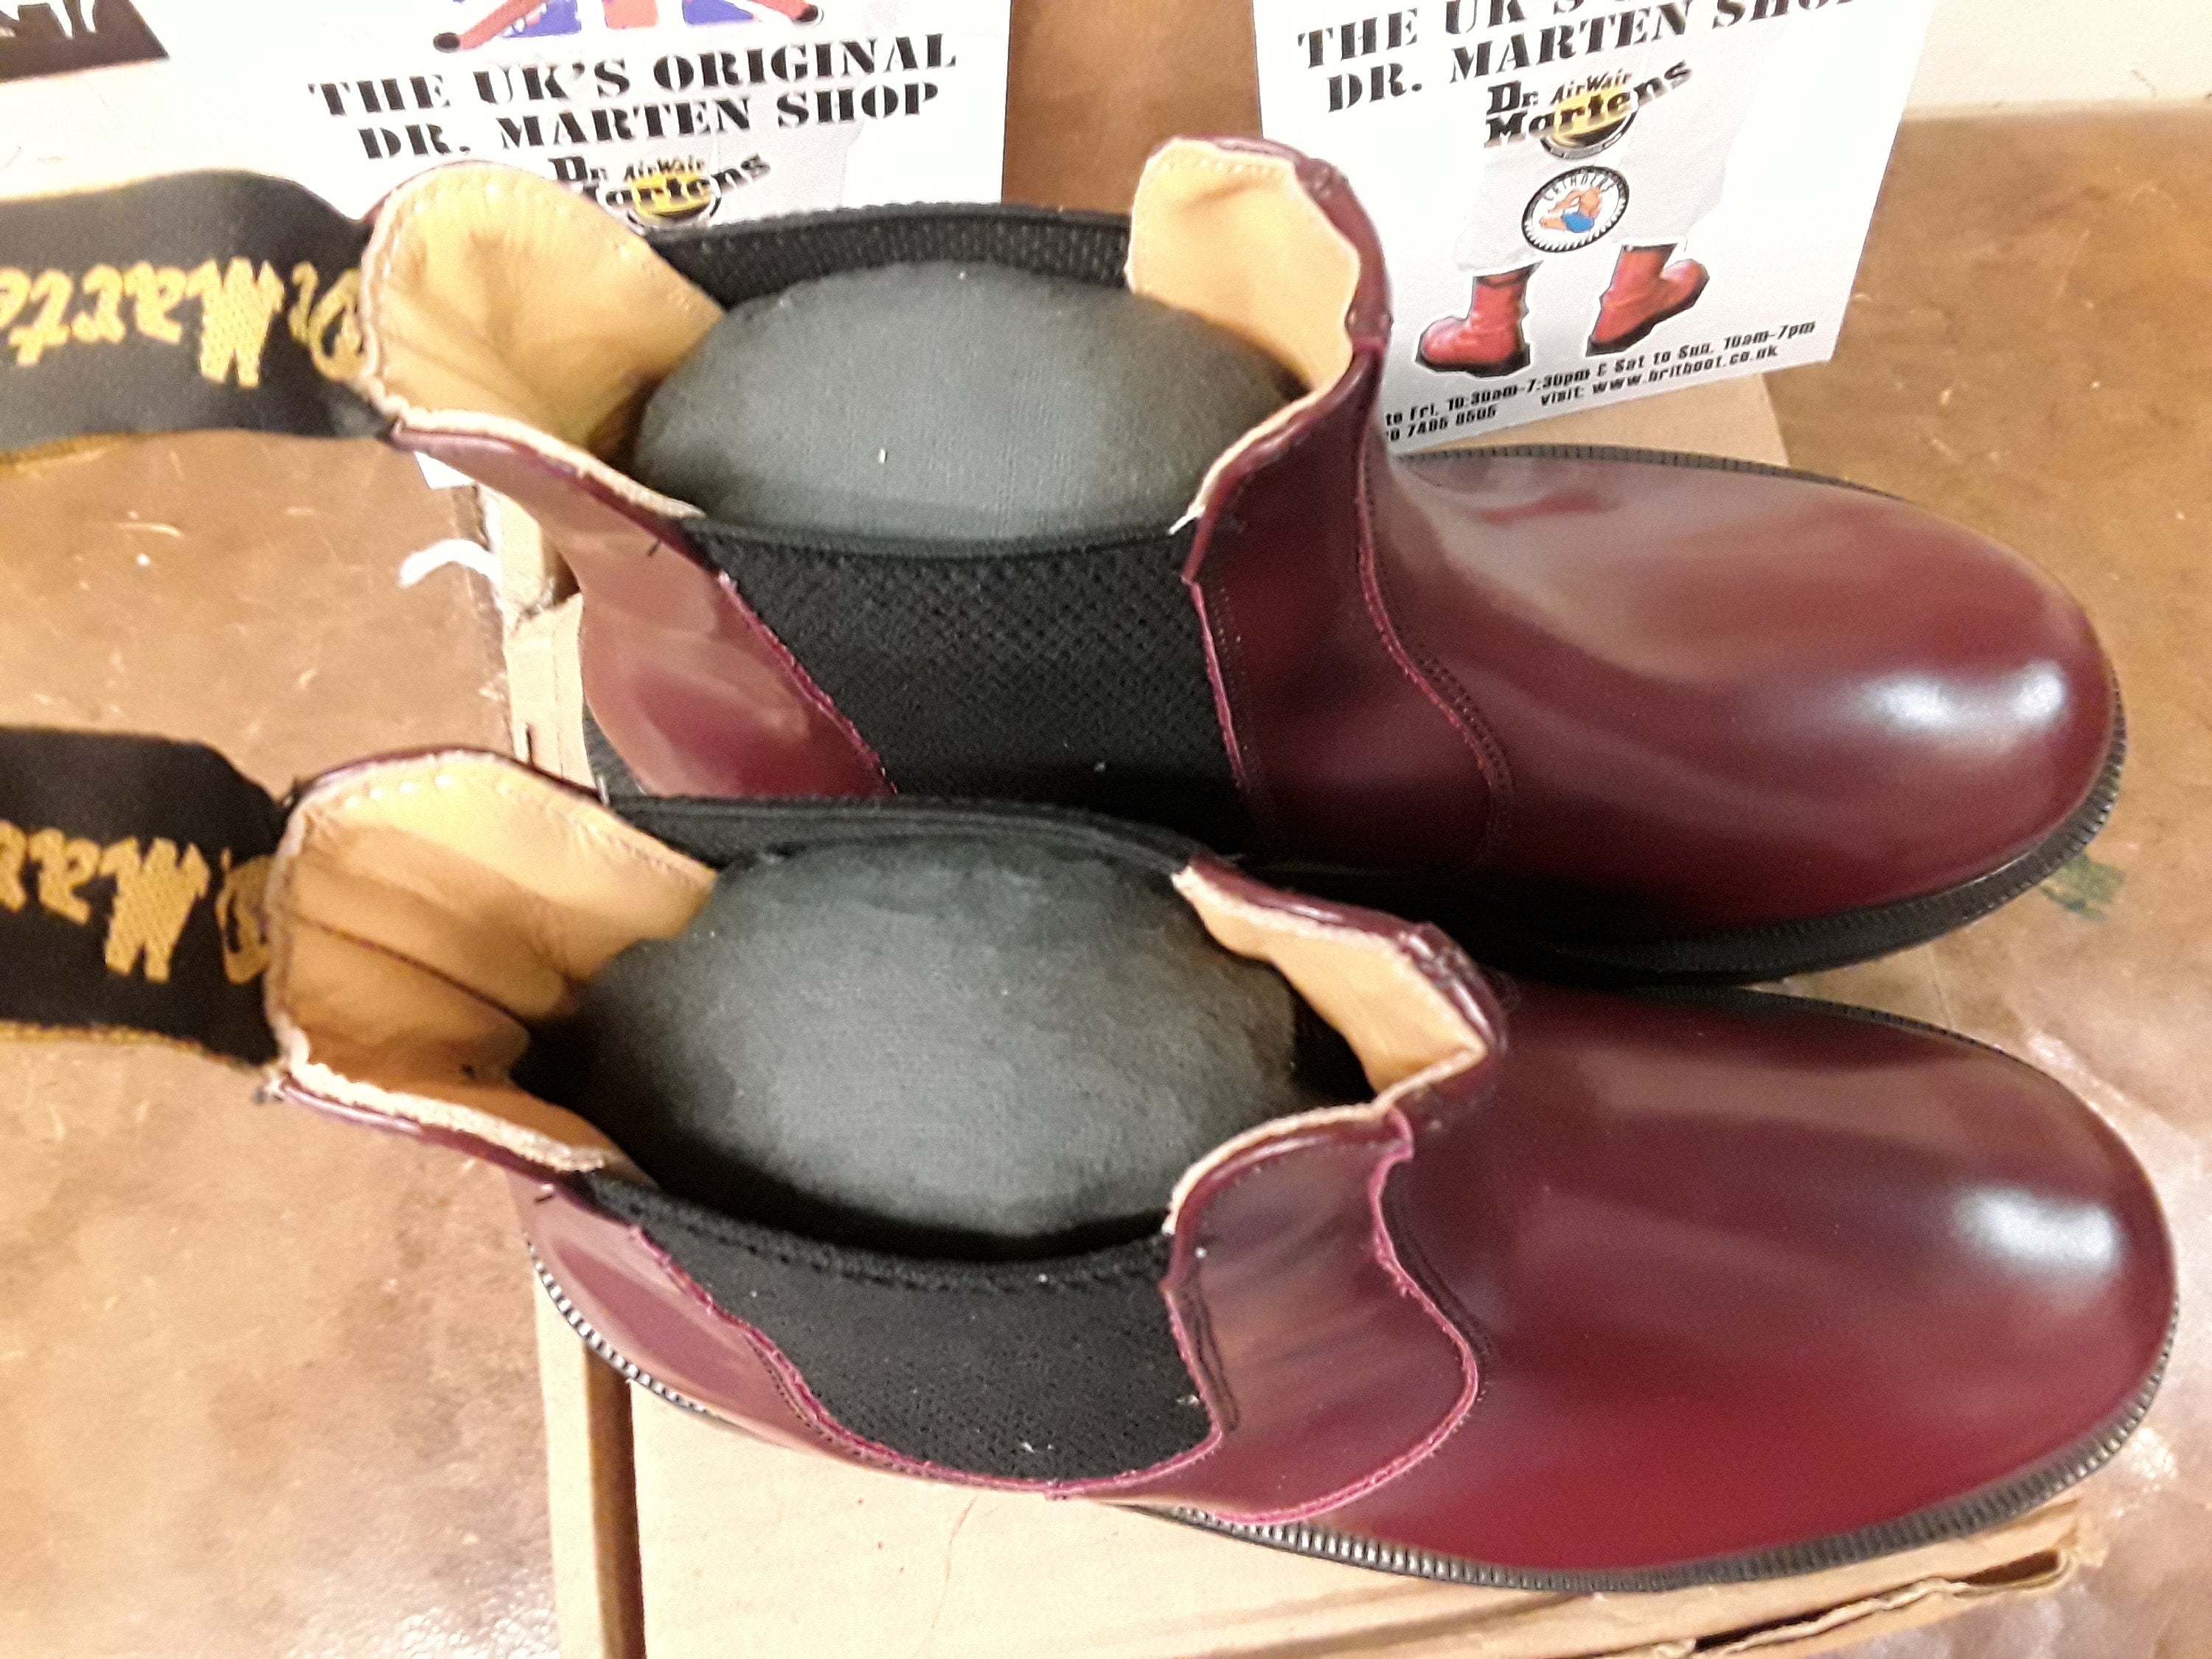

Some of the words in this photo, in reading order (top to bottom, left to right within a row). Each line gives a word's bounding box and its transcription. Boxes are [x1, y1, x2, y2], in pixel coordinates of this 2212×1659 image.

[308, 74, 451, 116] THE
[473, 57, 630, 105] UK'S
[653, 33, 956, 93] ORIGINAL
[1298, 8, 1418, 69] THE
[1328, 63, 1423, 113] DR.
[1450, 0, 1692, 83] MARTEN
[358, 124, 471, 159] DR.
[495, 96, 751, 150] MARTEN
[776, 82, 939, 129] SHOP
[1484, 59, 1692, 148] Martens
[1550, 67, 1632, 106] AirWair
[1385, 410, 1402, 427] to
[1614, 355, 1645, 373] Sat
[1654, 349, 1671, 365] to
[1678, 342, 1715, 359] Sun.
[1724, 321, 1817, 350] 10am-7pm
